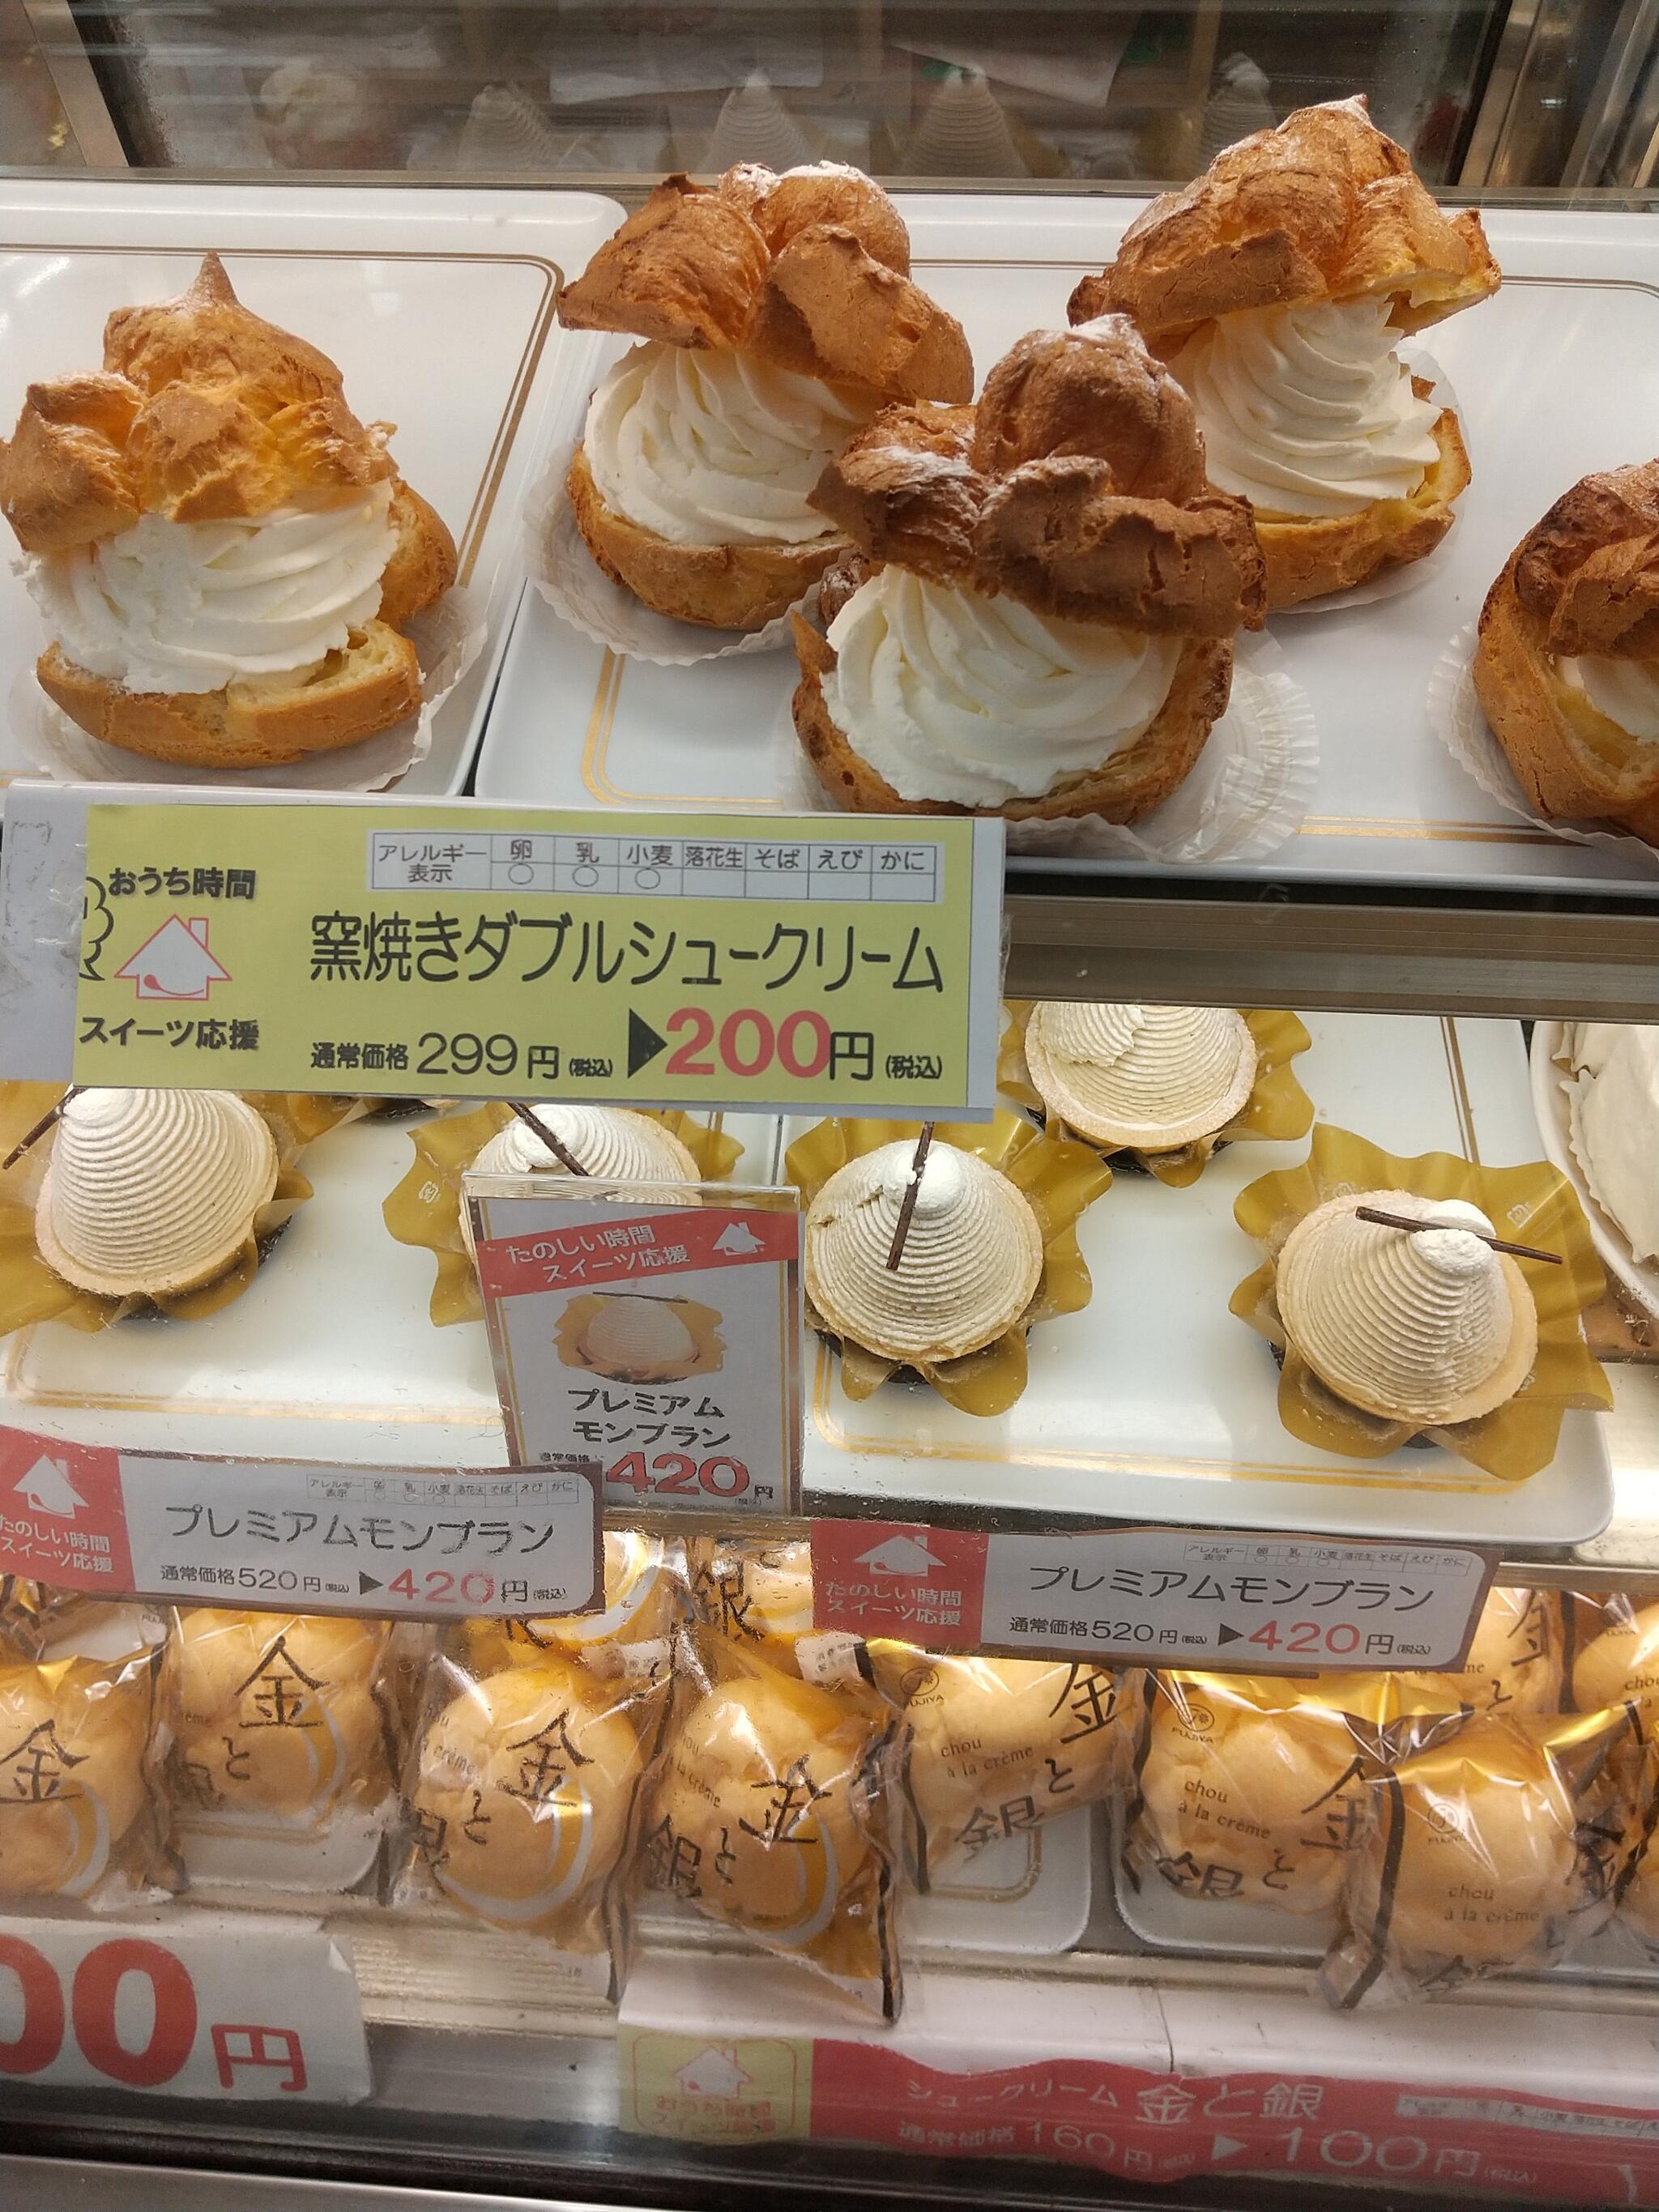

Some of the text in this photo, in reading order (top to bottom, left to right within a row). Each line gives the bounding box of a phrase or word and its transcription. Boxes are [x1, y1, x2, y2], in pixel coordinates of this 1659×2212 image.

[378, 840, 925, 870] アレルギー 卵 乳 小麦 落花生 そば えび かに
[109, 867, 256, 900] おうち時間
[407, 863, 452, 883] 表示
[311, 910, 943, 992] 窯焼きダブルシュークリーム
[79, 1016, 259, 1051] スイーツ応援
[505, 1225, 655, 1264] たのしい時間
[543, 1245, 690, 1282] スイーツ応援
[568, 1388, 725, 1417] プレミアム
[573, 1421, 731, 1449] モンブラン
[0, 1514, 111, 1554] たのしい時間
[166, 1503, 554, 1555] プレミアムモンブラン
[2, 1537, 115, 1574] スイーツ応援
[825, 1580, 962, 1607] たのしい時間
[1030, 1566, 1434, 1612] プレミアムモンブラン
[827, 1599, 962, 1626] スイーツ応援
[234, 1636, 330, 1728] 金
[904, 1694, 945, 1707] UJIYA
[0, 1719, 90, 1804] 金
[222, 1737, 250, 1780] と
[497, 1708, 595, 1806] 金
[941, 1739, 982, 1758] chou
[962, 1762, 978, 1777] la
[1045, 1758, 1073, 1793] と
[1184, 1779, 1228, 1803] chou
[463, 1790, 491, 1846] と
[1195, 1804, 1210, 1821] la
[1262, 1848, 1295, 1890] と
[1448, 1885, 1495, 1900] chou
[906, 2076, 1324, 2124] シュークリーム 金と銀
